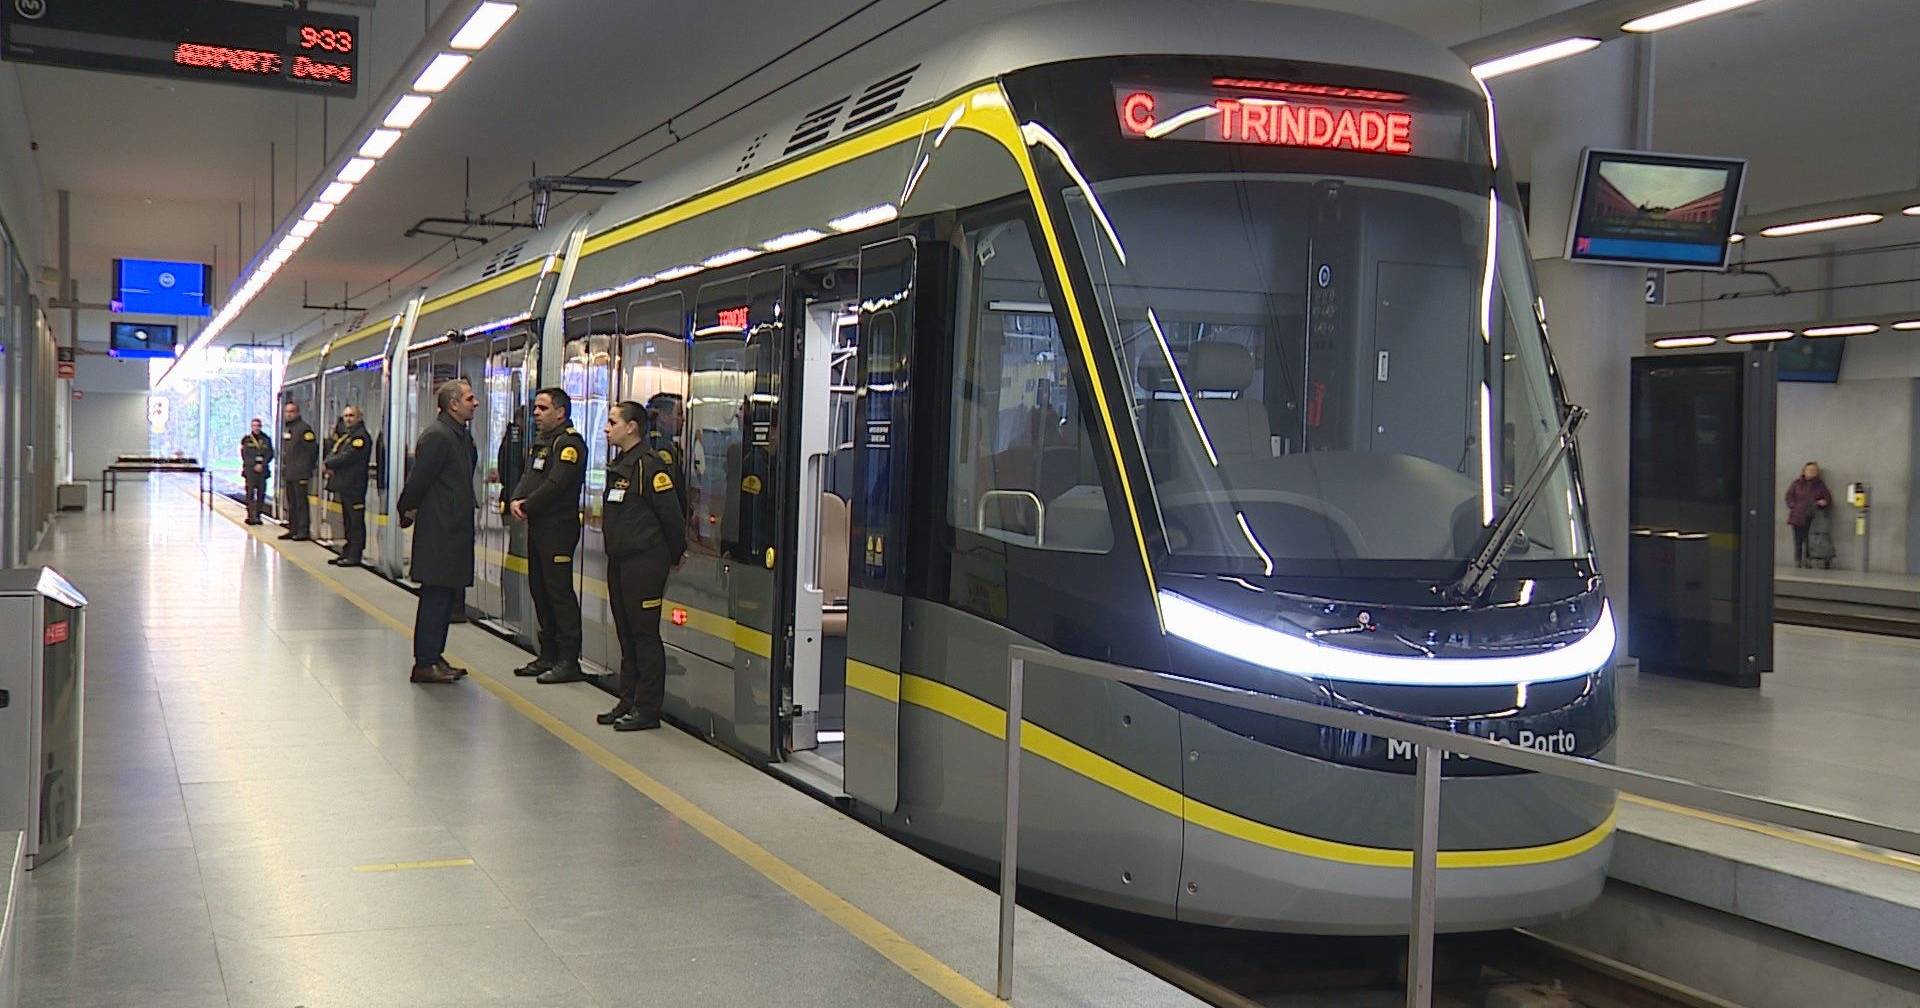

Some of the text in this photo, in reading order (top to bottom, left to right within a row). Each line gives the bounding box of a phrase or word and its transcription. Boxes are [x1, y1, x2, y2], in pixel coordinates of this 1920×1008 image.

[174, 43, 282, 73] AIRPORT:
[1123, 92, 1411, 152] C TRINDADE
[1645, 280, 1657, 302] 2
[1519, 729, 1576, 754] Porto
